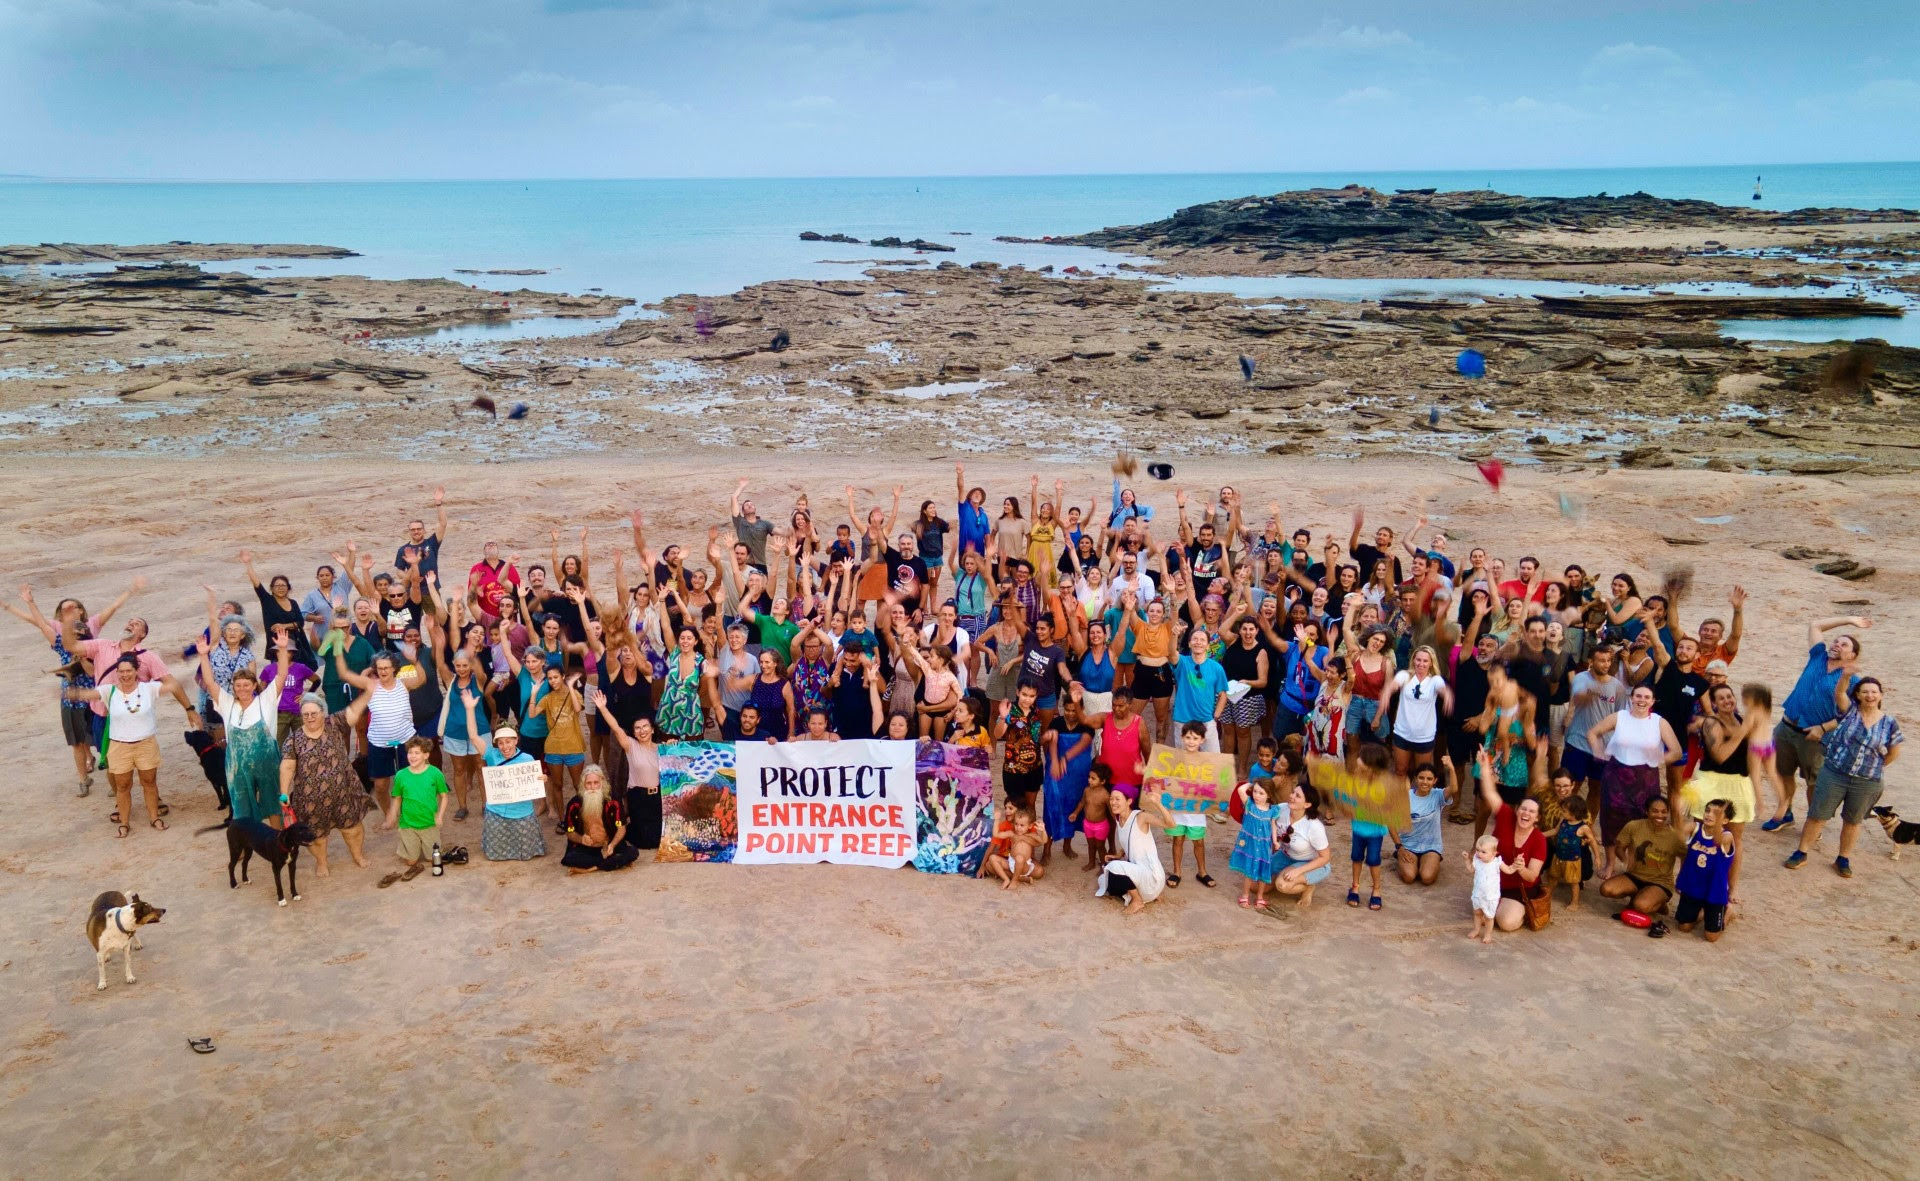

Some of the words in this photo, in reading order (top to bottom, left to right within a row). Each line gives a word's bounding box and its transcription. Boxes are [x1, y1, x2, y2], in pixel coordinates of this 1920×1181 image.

[487, 769, 504, 779] STOP
[508, 763, 539, 777] FUNDING
[515, 774, 536, 786] THAT
[760, 765, 893, 799] PROTECT
[752, 802, 905, 829] ENTRANCE
[745, 832, 834, 854] POINT
[841, 833, 912, 857] REEF
